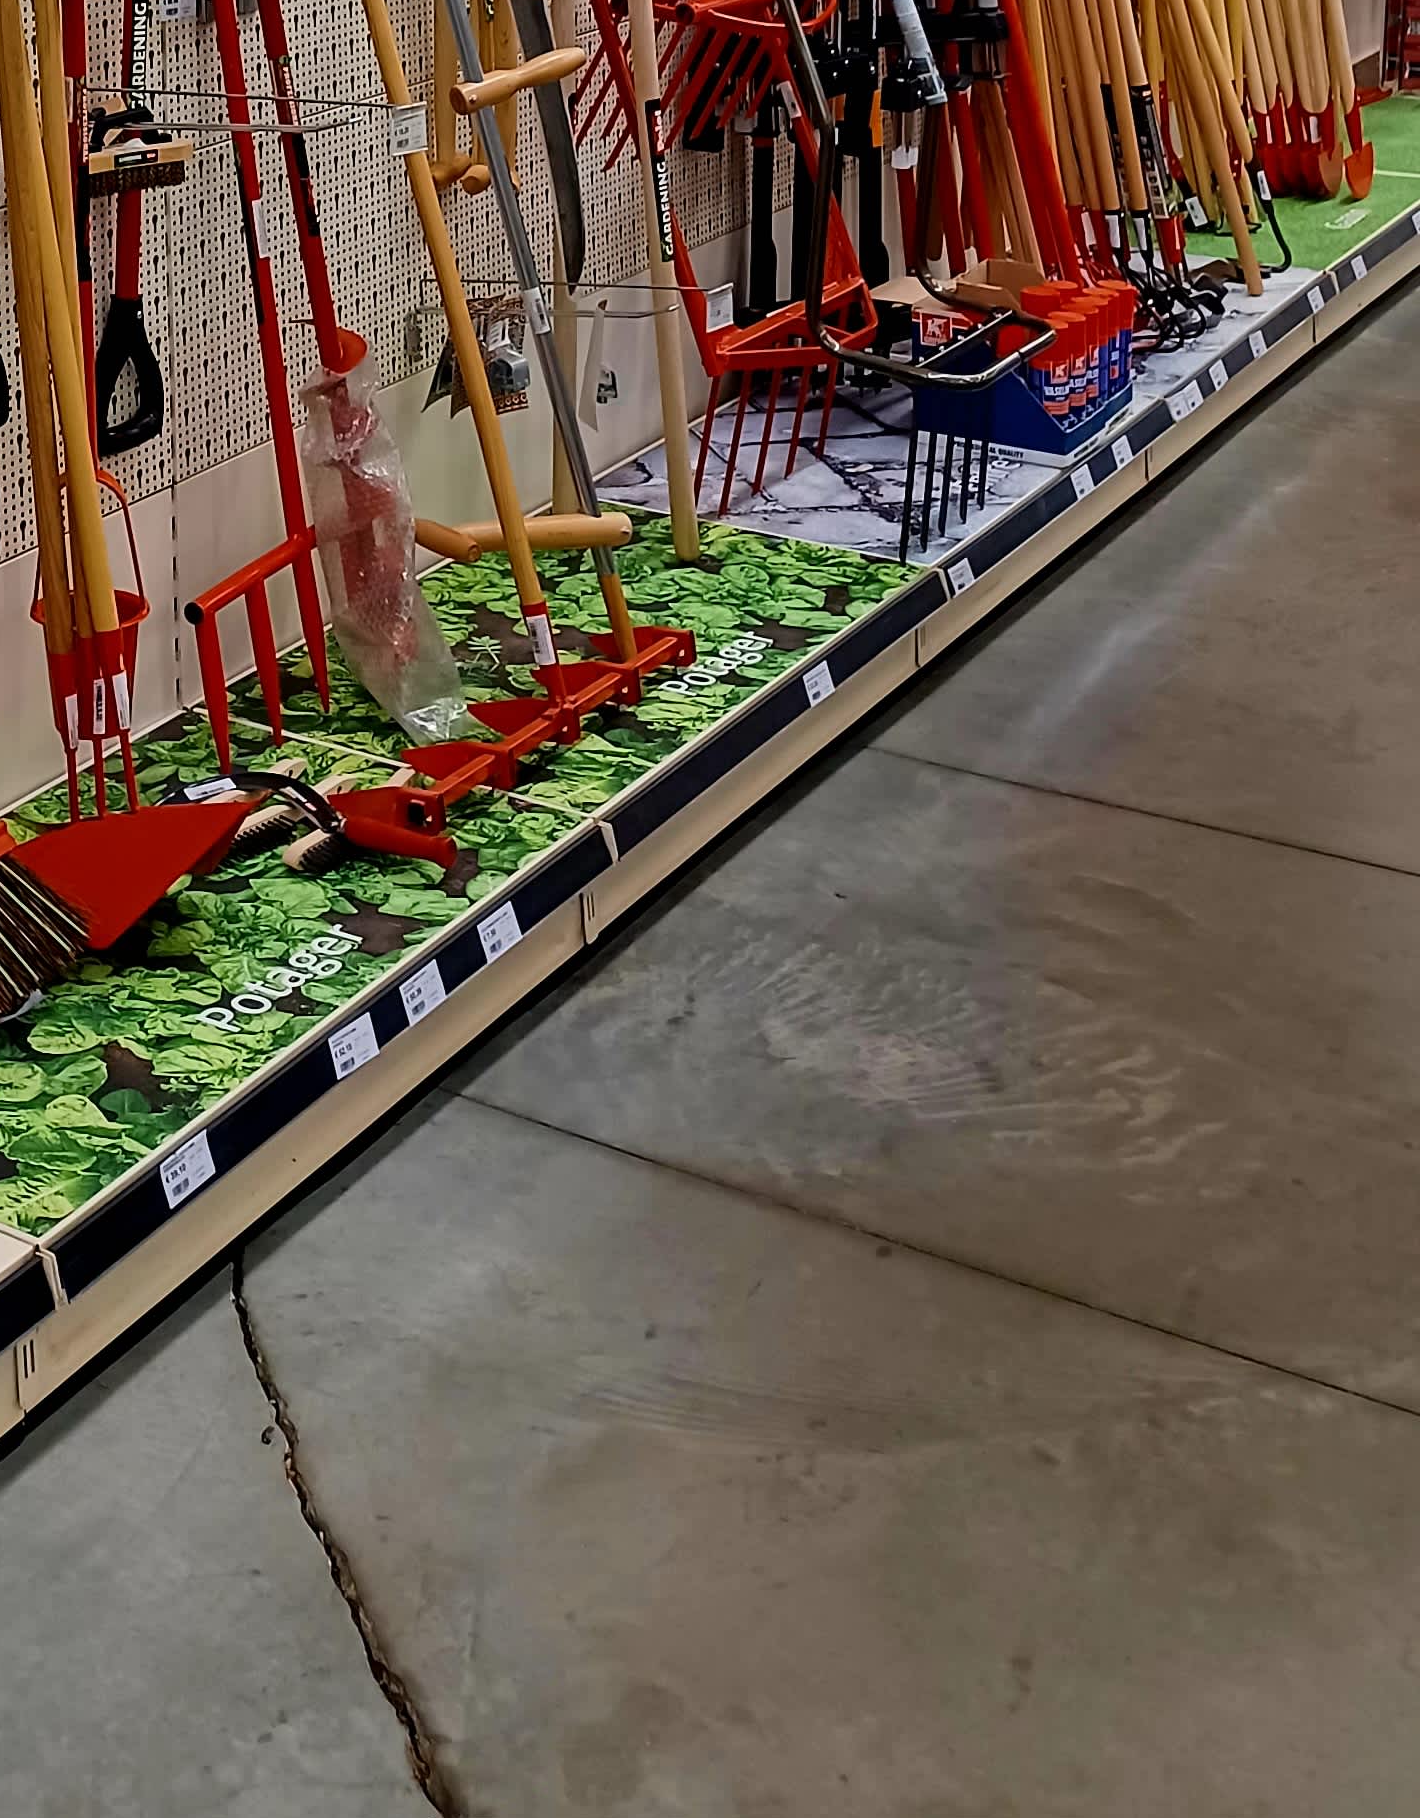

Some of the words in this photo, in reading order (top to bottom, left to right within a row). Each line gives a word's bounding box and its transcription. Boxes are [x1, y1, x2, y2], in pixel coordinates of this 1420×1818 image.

[658, 160, 674, 256] GARDENING
[659, 630, 774, 696] Potager
[197, 922, 364, 1034] Potager
